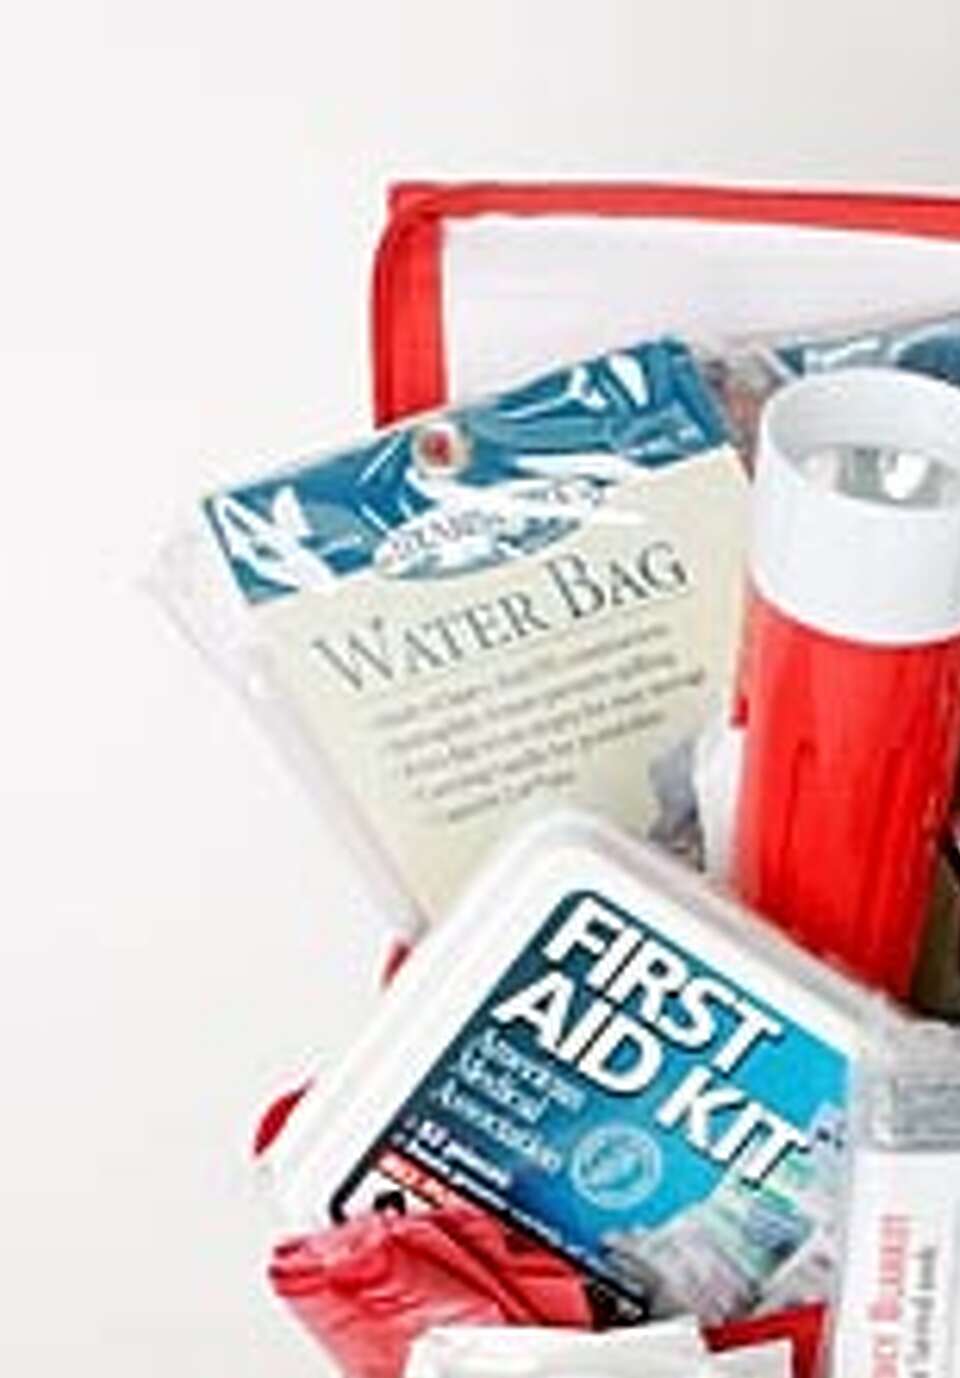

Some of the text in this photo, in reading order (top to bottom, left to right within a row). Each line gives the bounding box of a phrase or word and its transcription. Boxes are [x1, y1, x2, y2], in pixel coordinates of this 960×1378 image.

[312, 591, 549, 692] WATER
[544, 541, 688, 619] BAG
[543, 897, 783, 1074] FIRST
[492, 969, 808, 1185] AID KIT
